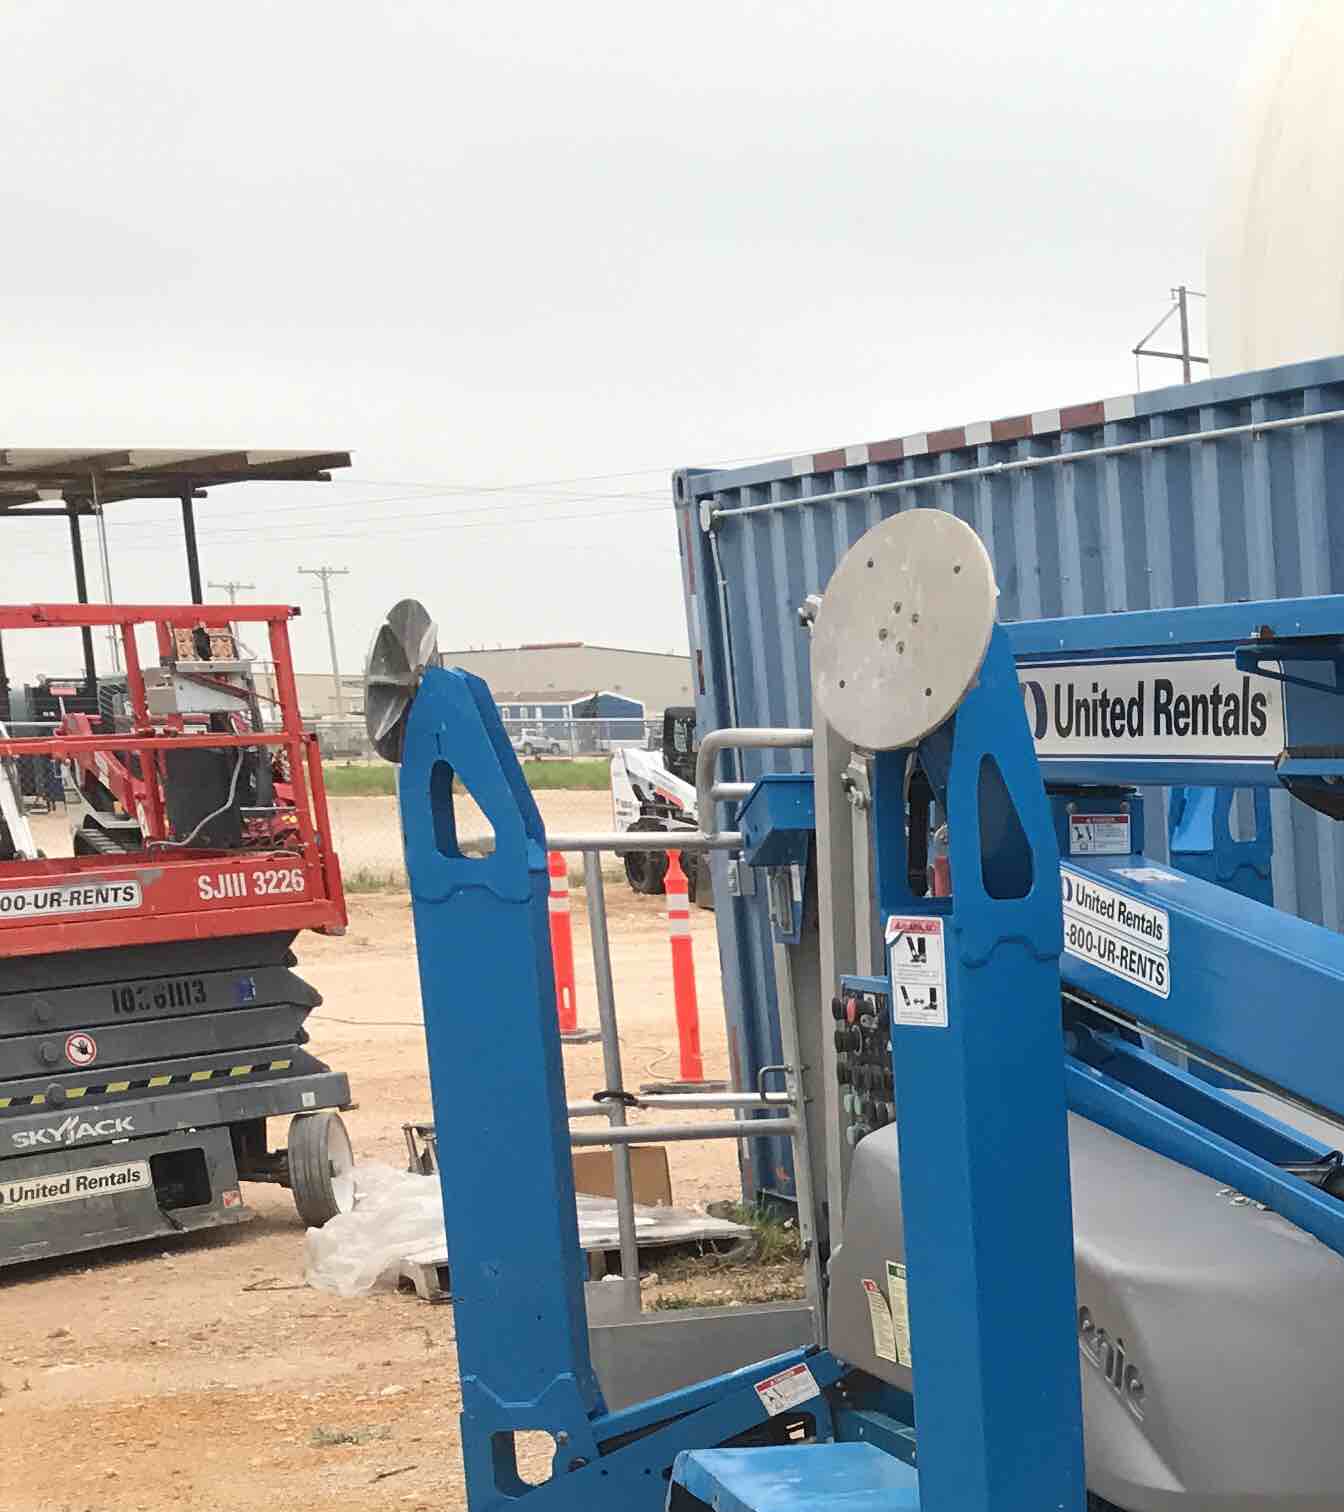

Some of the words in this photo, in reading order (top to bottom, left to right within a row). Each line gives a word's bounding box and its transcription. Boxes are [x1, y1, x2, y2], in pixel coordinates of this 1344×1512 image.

[1053, 681, 1144, 738] United
[1153, 676, 1268, 737] Rentals
[252, 868, 305, 896] 3226
[1075, 883, 1115, 920] United
[1118, 901, 1164, 941] Rentals
[1065, 923, 1165, 986] -800-UR-RENTS
[11, 1115, 135, 1148] SKYJACK
[9, 1179, 70, 1203] United
[76, 1168, 141, 1192] Rentals
